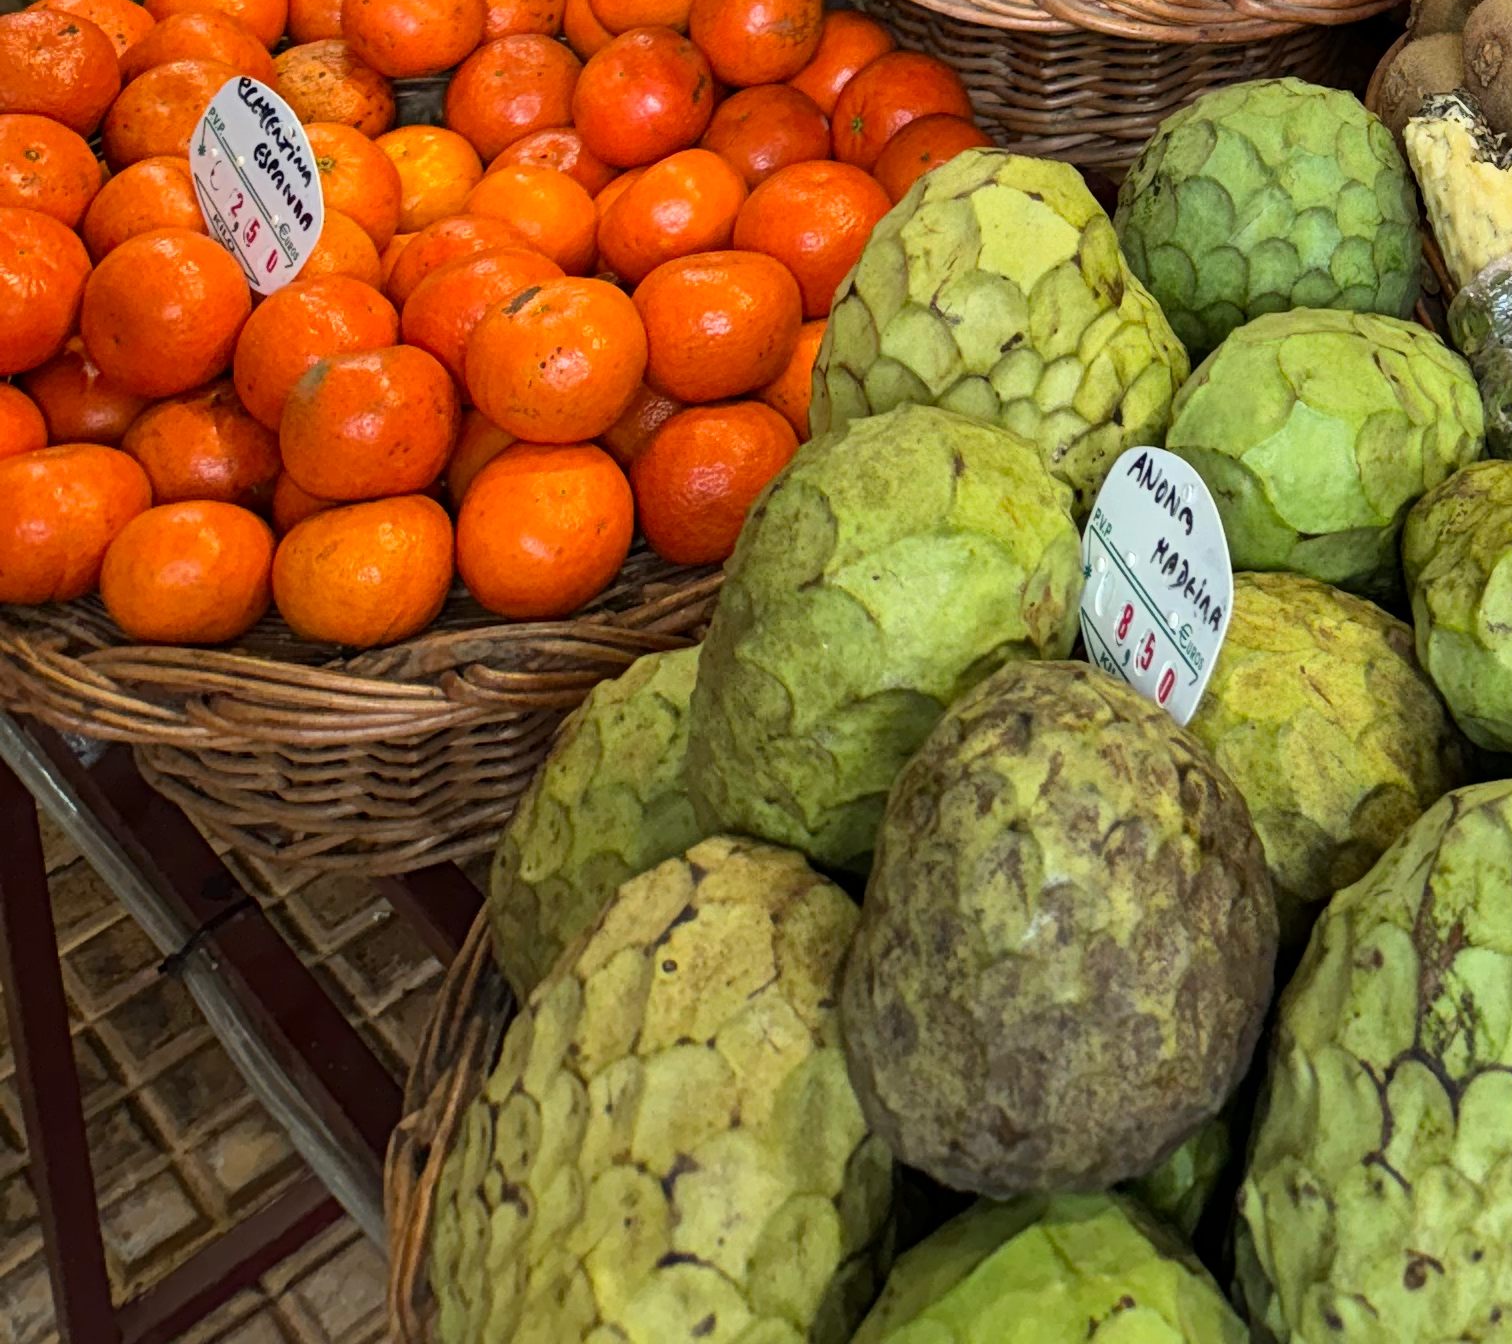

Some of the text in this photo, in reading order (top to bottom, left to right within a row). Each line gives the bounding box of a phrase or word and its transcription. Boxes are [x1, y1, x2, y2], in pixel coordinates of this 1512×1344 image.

[213, 213, 235, 252] KILO
[1127, 452, 1194, 535] ANONA
[1151, 537, 1223, 633] MADEIRA
[1117, 602, 1176, 705] 8,50
